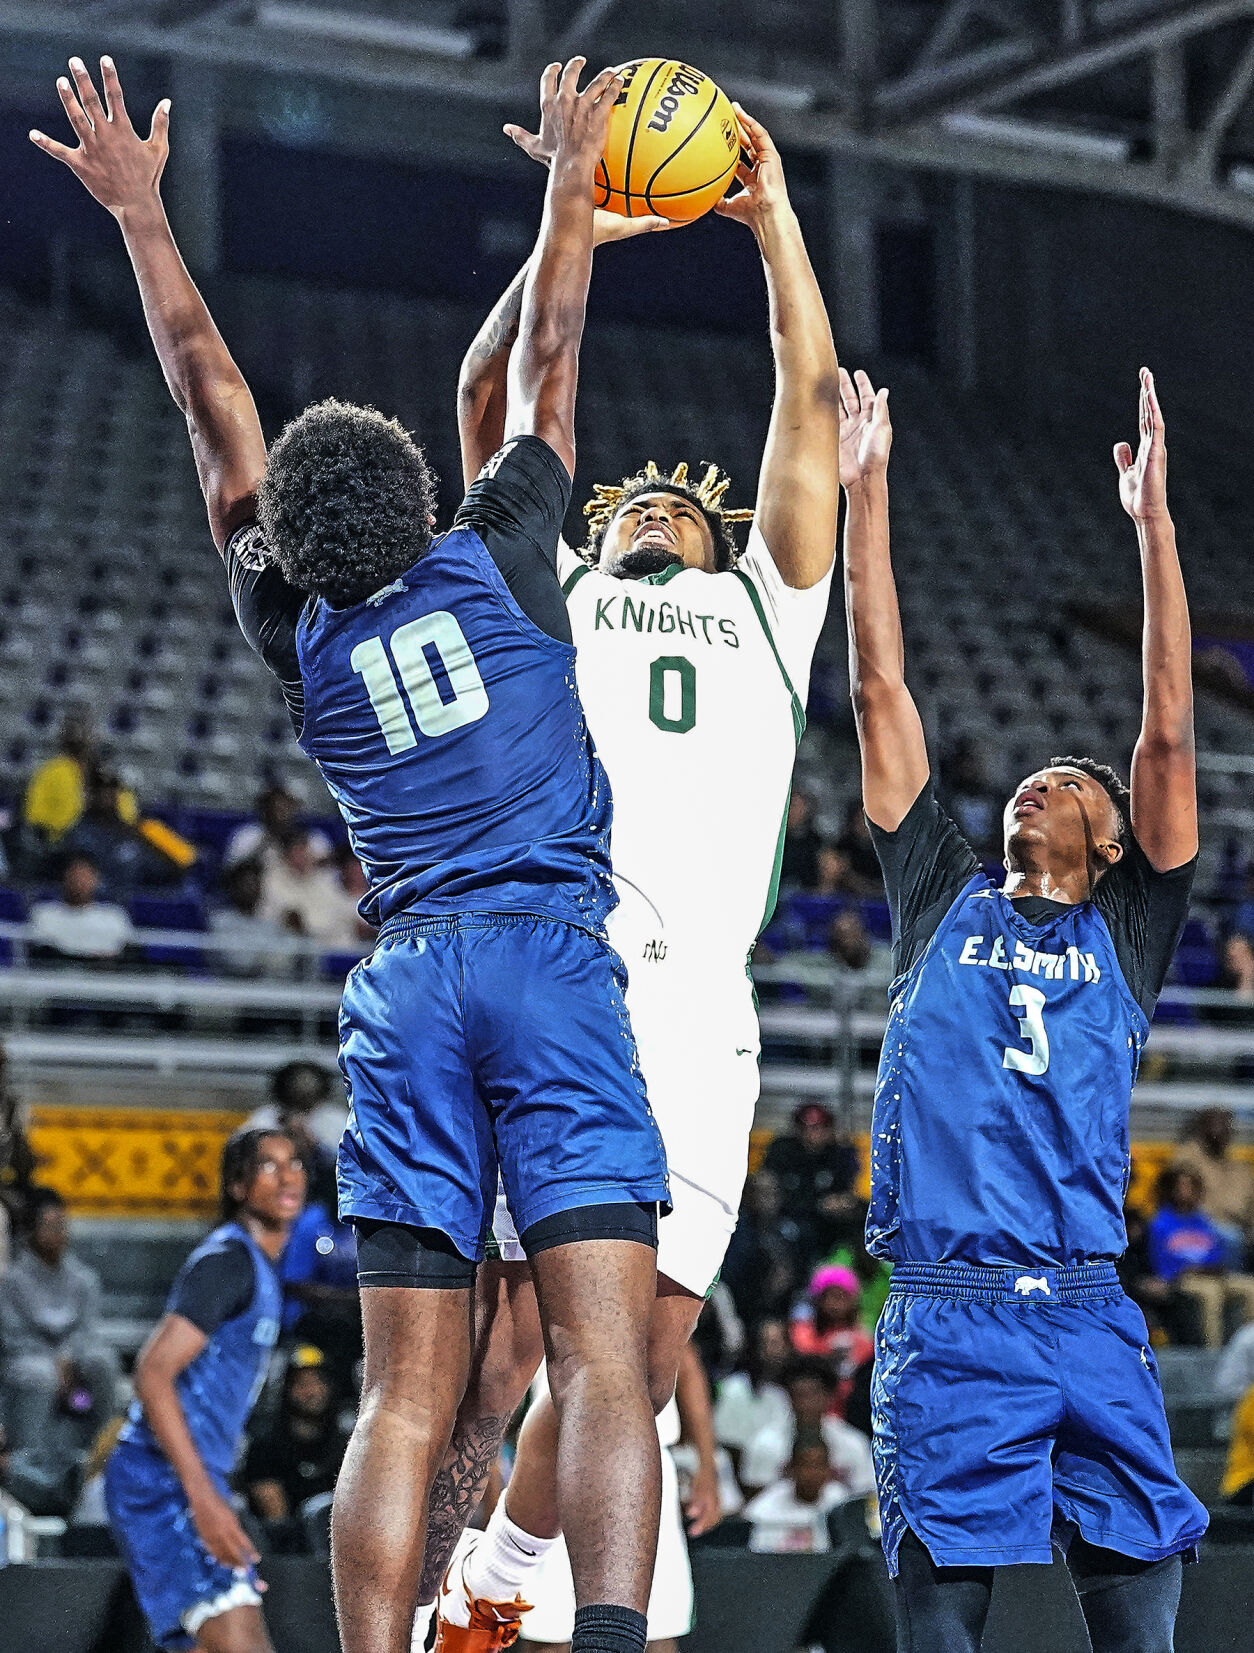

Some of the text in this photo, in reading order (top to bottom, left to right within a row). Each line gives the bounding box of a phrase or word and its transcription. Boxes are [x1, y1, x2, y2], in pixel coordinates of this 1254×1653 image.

[594, 596, 740, 649] KNIGHTS
[350, 610, 490, 757] 10
[648, 655, 697, 734] 0
[1002, 984, 1050, 1076] 3
